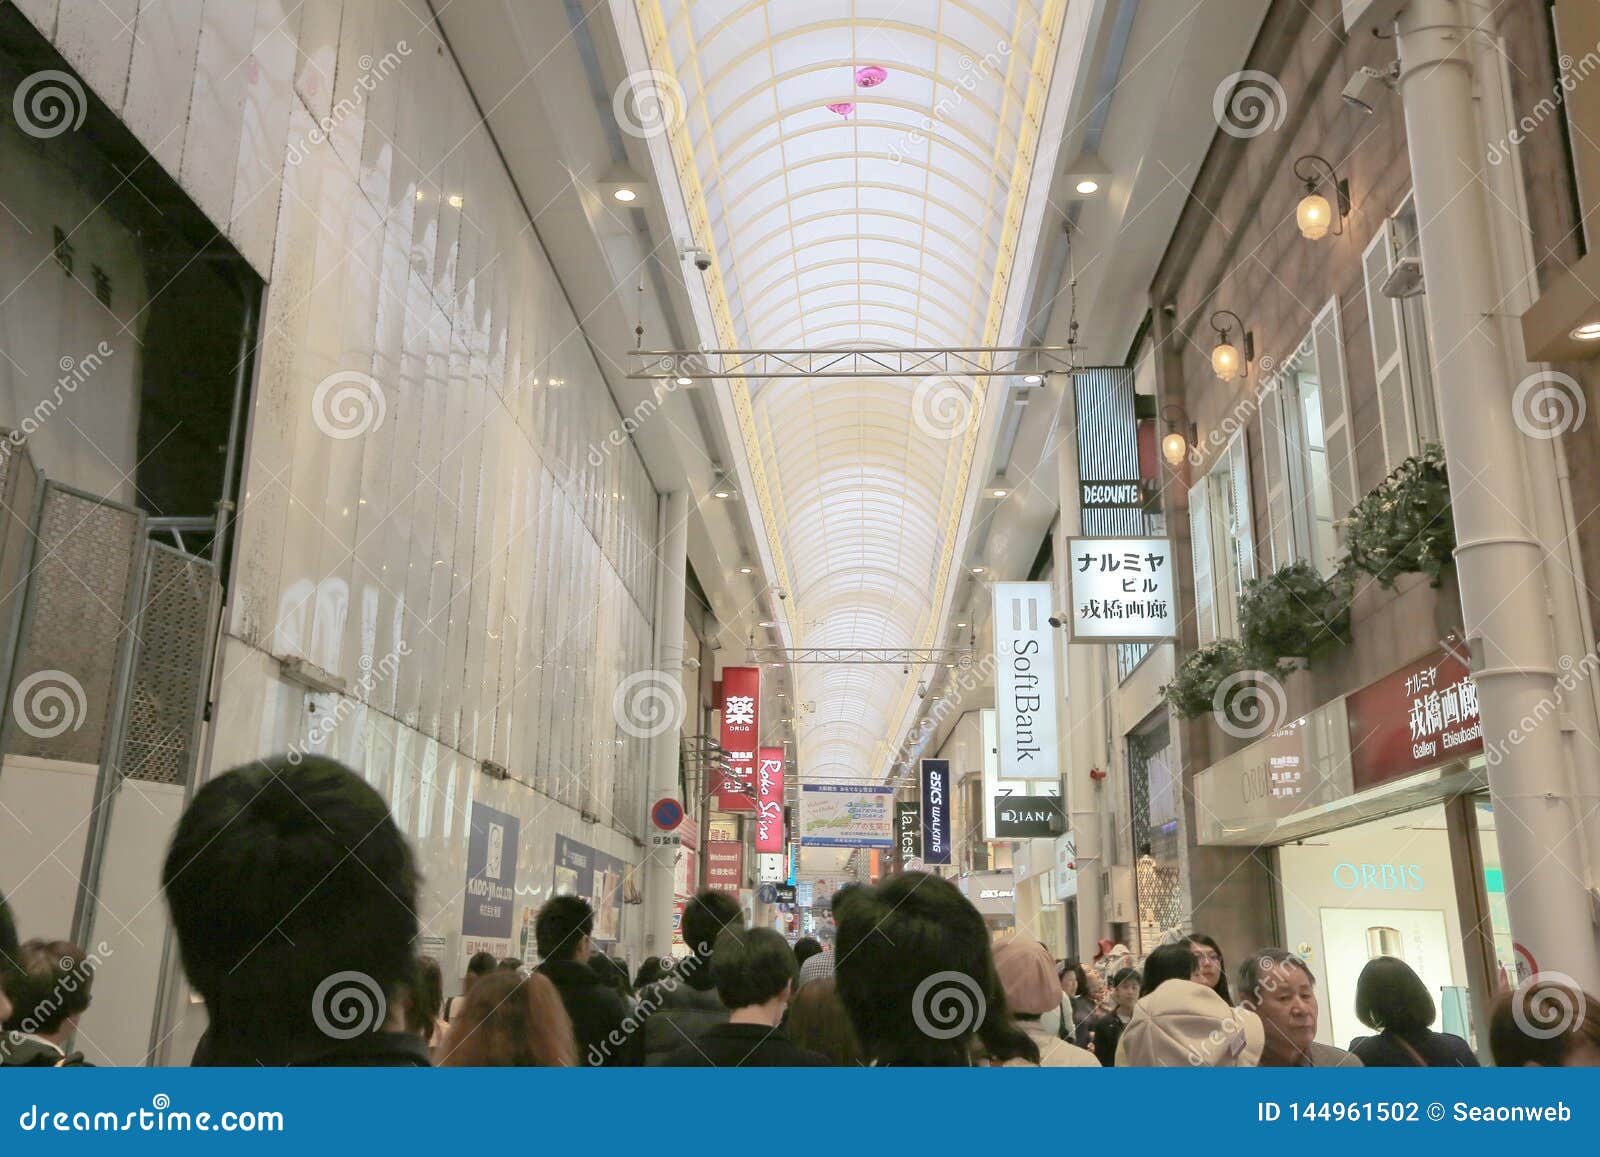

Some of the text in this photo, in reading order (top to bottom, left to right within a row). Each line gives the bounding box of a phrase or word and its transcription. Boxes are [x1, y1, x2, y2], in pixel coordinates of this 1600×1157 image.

[1083, 485, 1138, 504] DECOUNTE
[1078, 553, 1164, 572] ナルミヤ
[1122, 578, 1158, 593] ビル
[1080, 599, 1168, 619] 戎橋画廊
[1405, 667, 1437, 697] ナルミヤ
[725, 695, 754, 725] 薬
[1013, 639, 1041, 763] SoftBank
[1412, 721, 1483, 759] Gallery Ebisubashi
[1332, 863, 1425, 891] ORBIS
